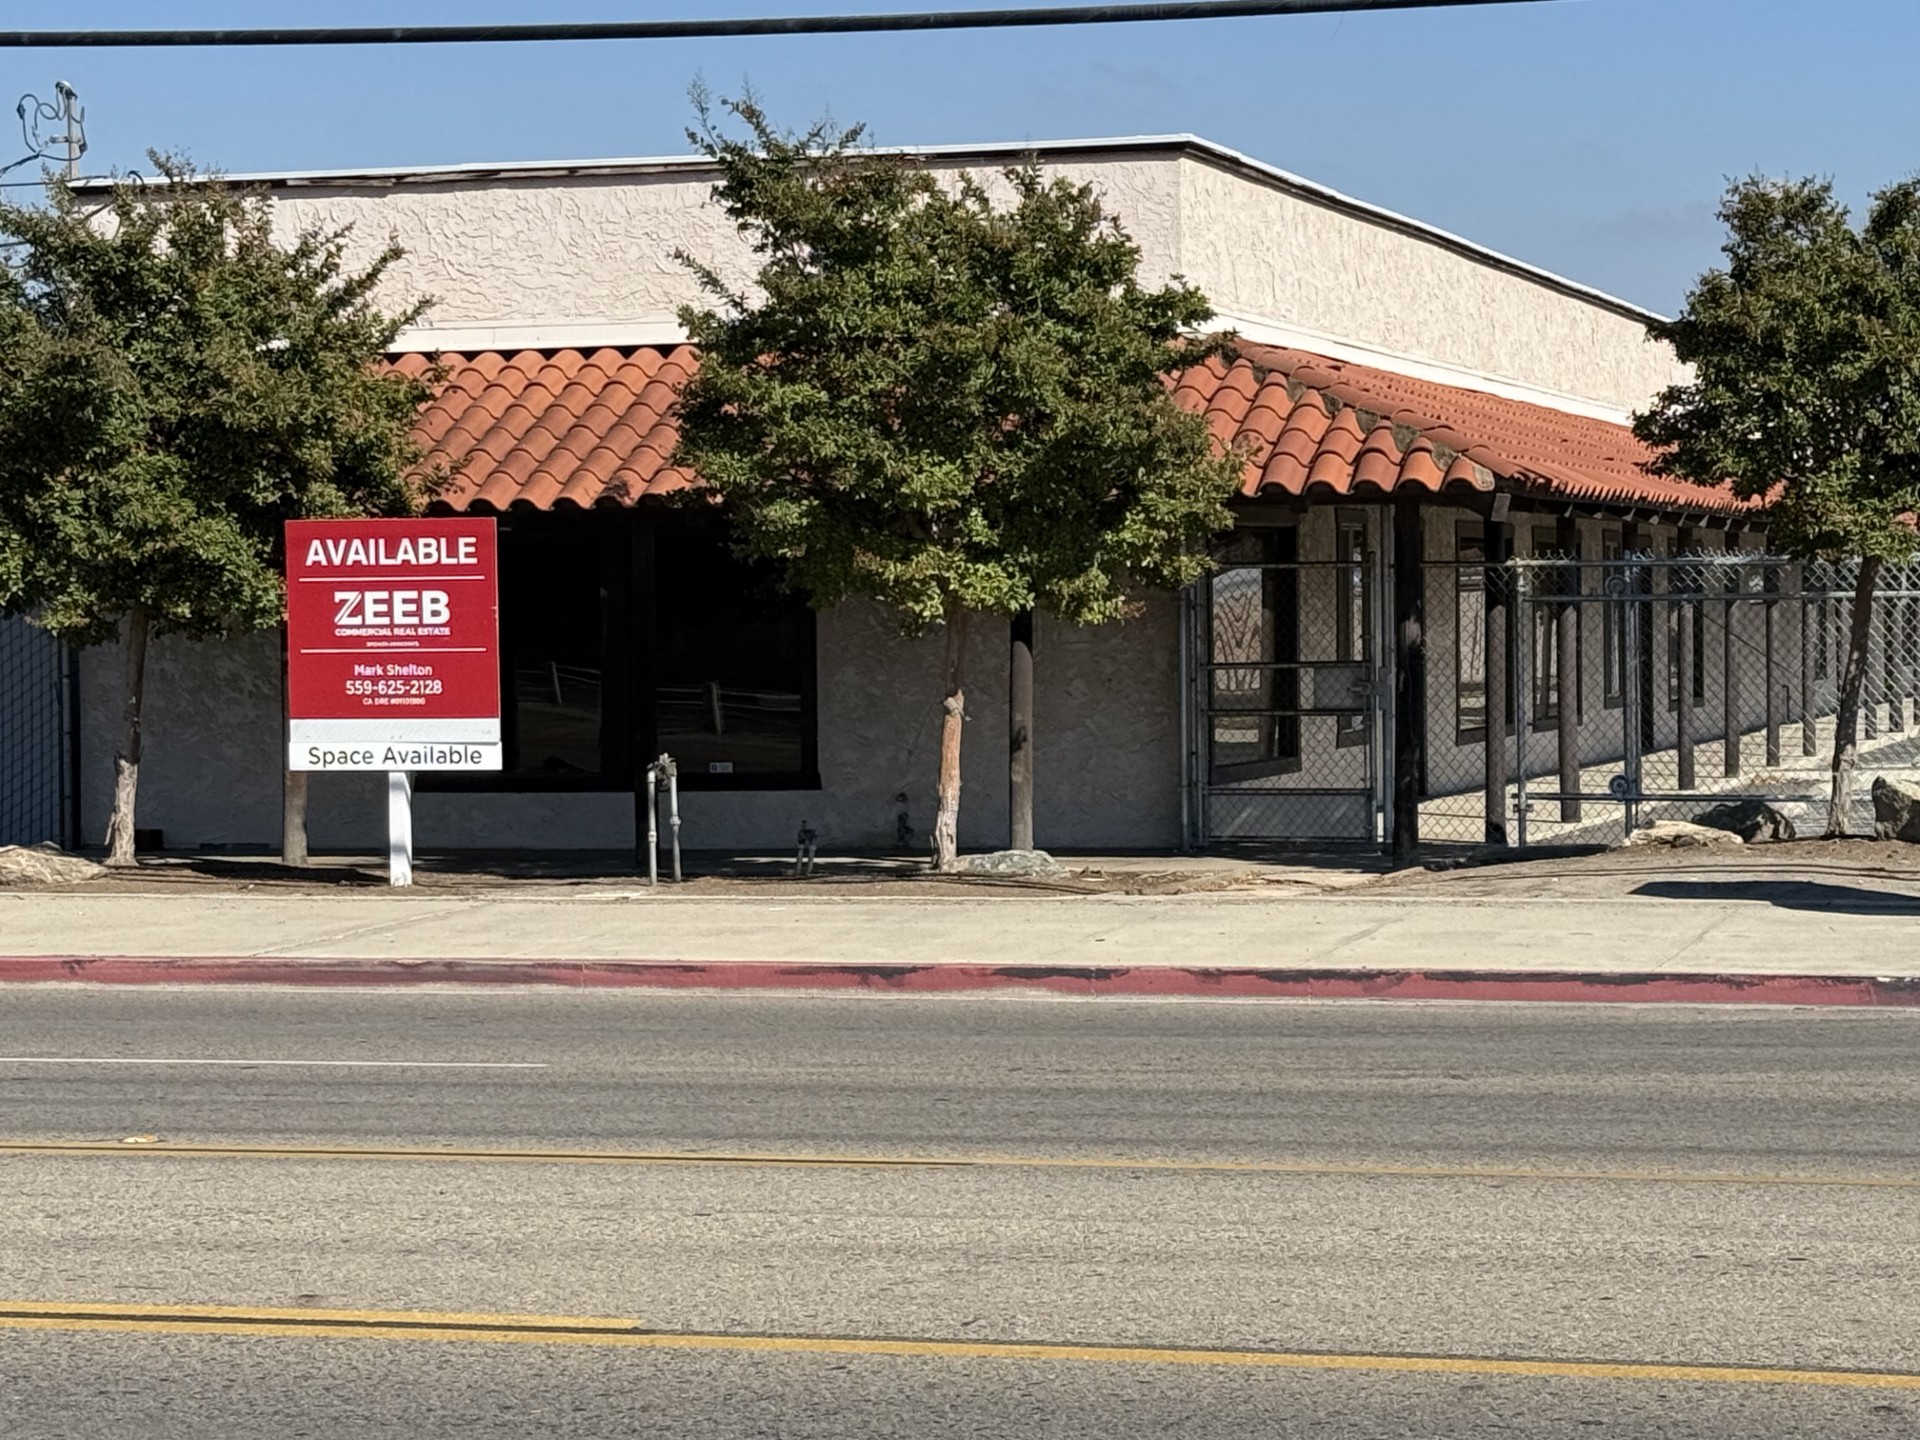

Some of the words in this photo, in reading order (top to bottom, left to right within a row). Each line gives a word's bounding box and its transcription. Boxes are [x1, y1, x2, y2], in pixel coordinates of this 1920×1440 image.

[305, 537, 477, 566] AVAILABLE
[334, 590, 451, 625] ZEEB
[334, 627, 392, 637] COMMERCIAL
[393, 627, 417, 636] REAL
[417, 626, 451, 636] ESTATE
[354, 664, 384, 676] Mark
[386, 663, 433, 676] Shelton
[345, 680, 443, 695] 559-625-2128
[308, 746, 374, 768] Space
[382, 745, 483, 765] Available
